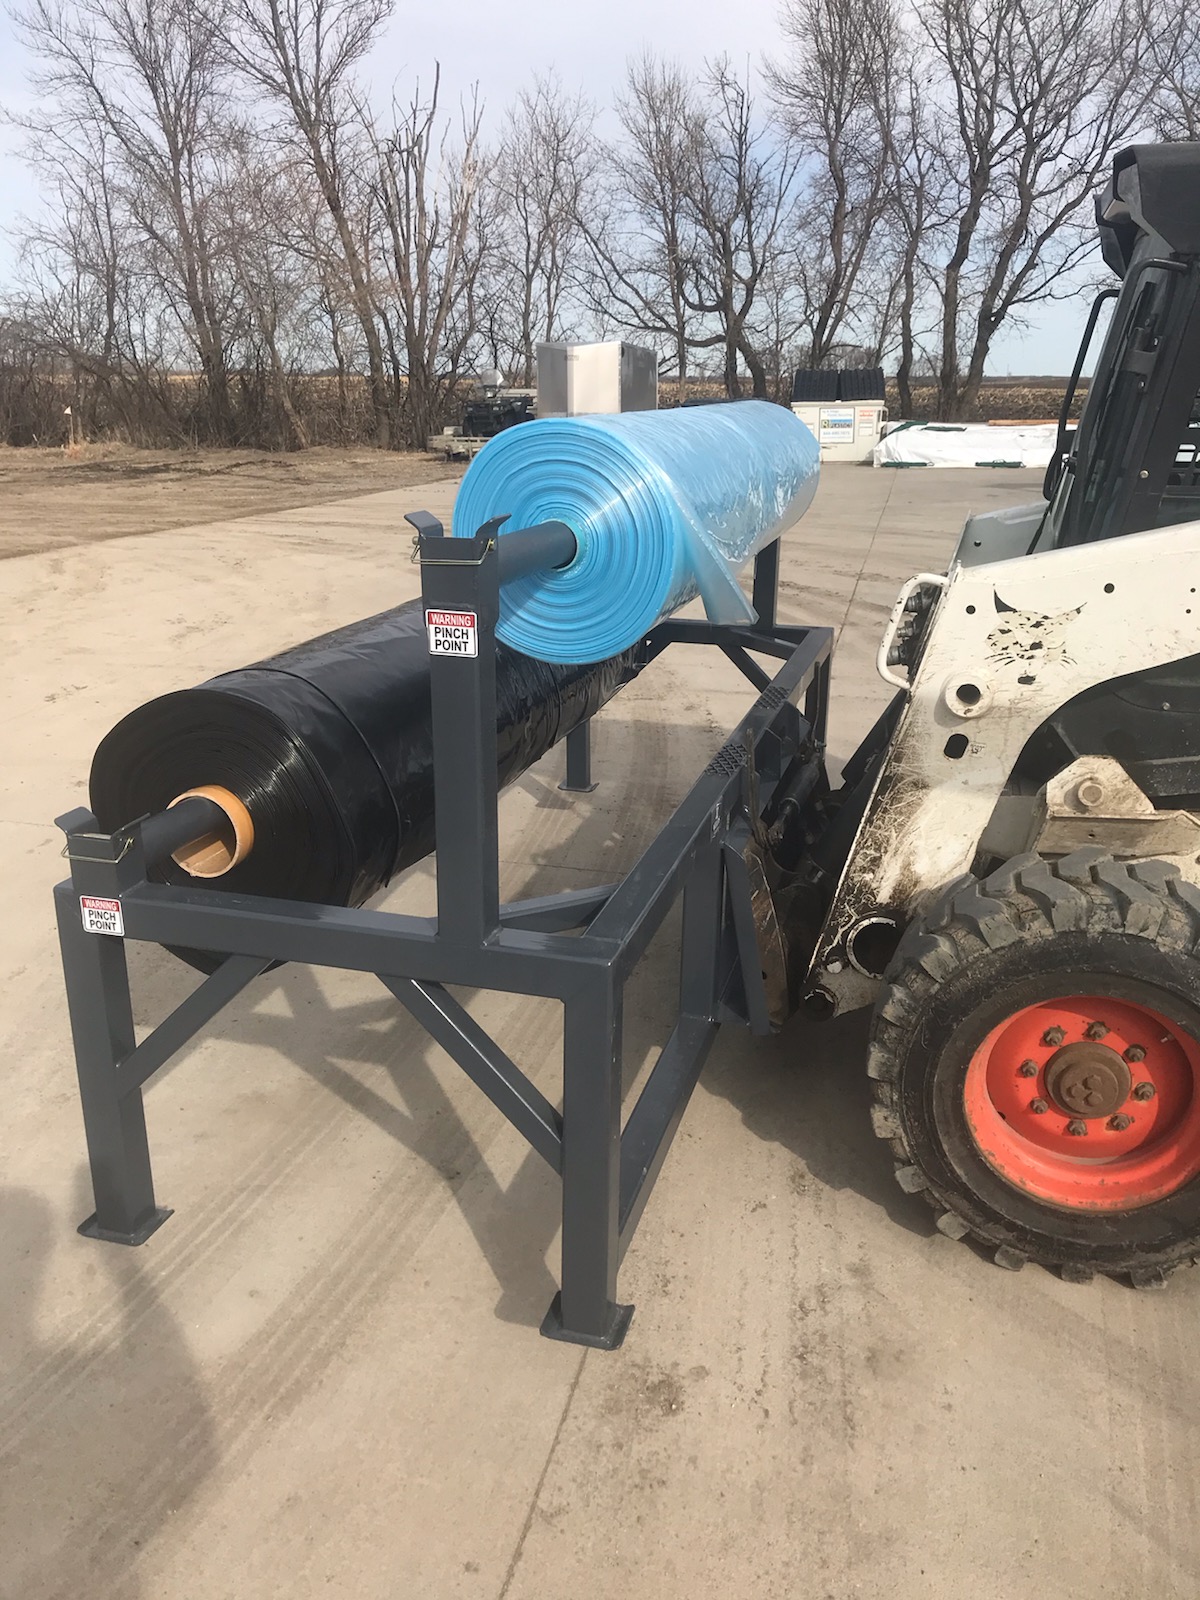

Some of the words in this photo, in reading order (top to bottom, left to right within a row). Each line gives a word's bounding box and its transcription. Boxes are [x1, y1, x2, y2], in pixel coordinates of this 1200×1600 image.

[430, 613, 472, 627] WARNING
[434, 626, 469, 640] PINCH
[435, 639, 469, 652] POINT
[84, 899, 117, 911] WARNING
[88, 910, 116, 921] PINCH
[90, 920, 117, 931] POINT
